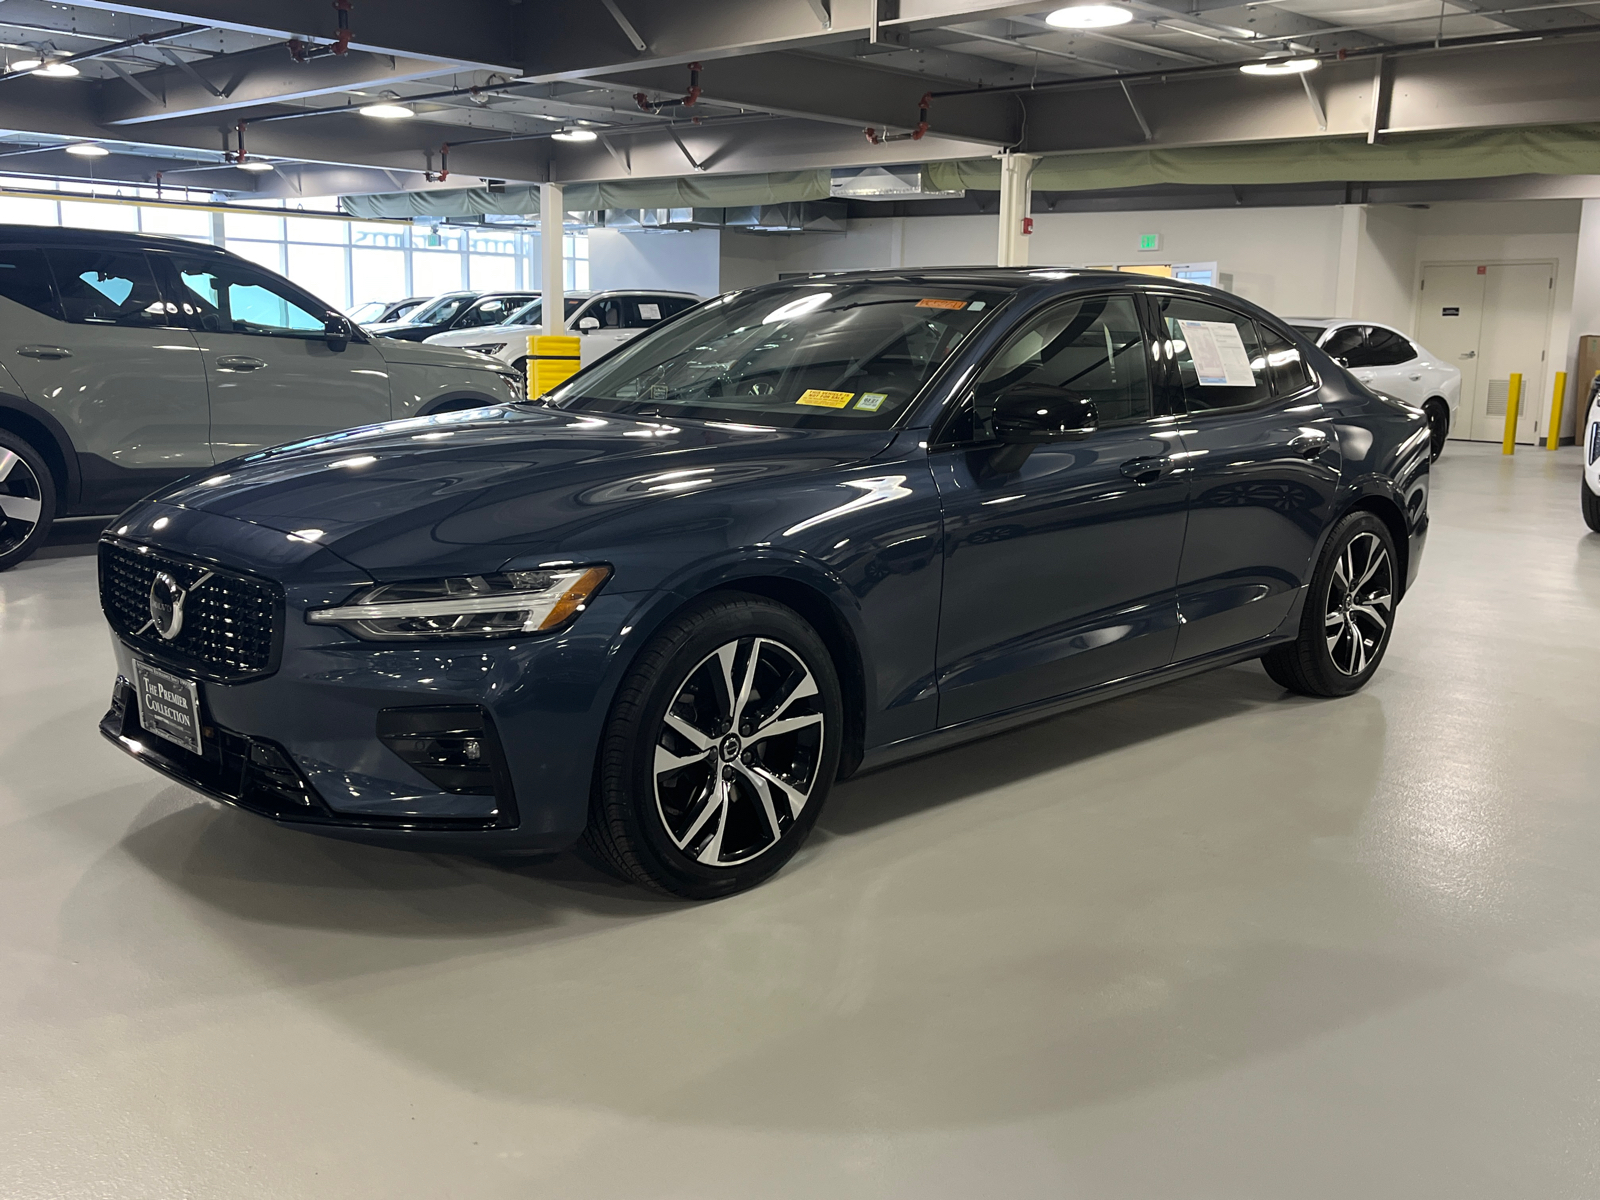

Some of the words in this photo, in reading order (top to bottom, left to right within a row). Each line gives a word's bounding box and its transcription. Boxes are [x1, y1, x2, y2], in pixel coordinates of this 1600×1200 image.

[143, 676, 158, 698] THE
[158, 683, 188, 709] PREMIER
[145, 693, 191, 727] COLLECTION
